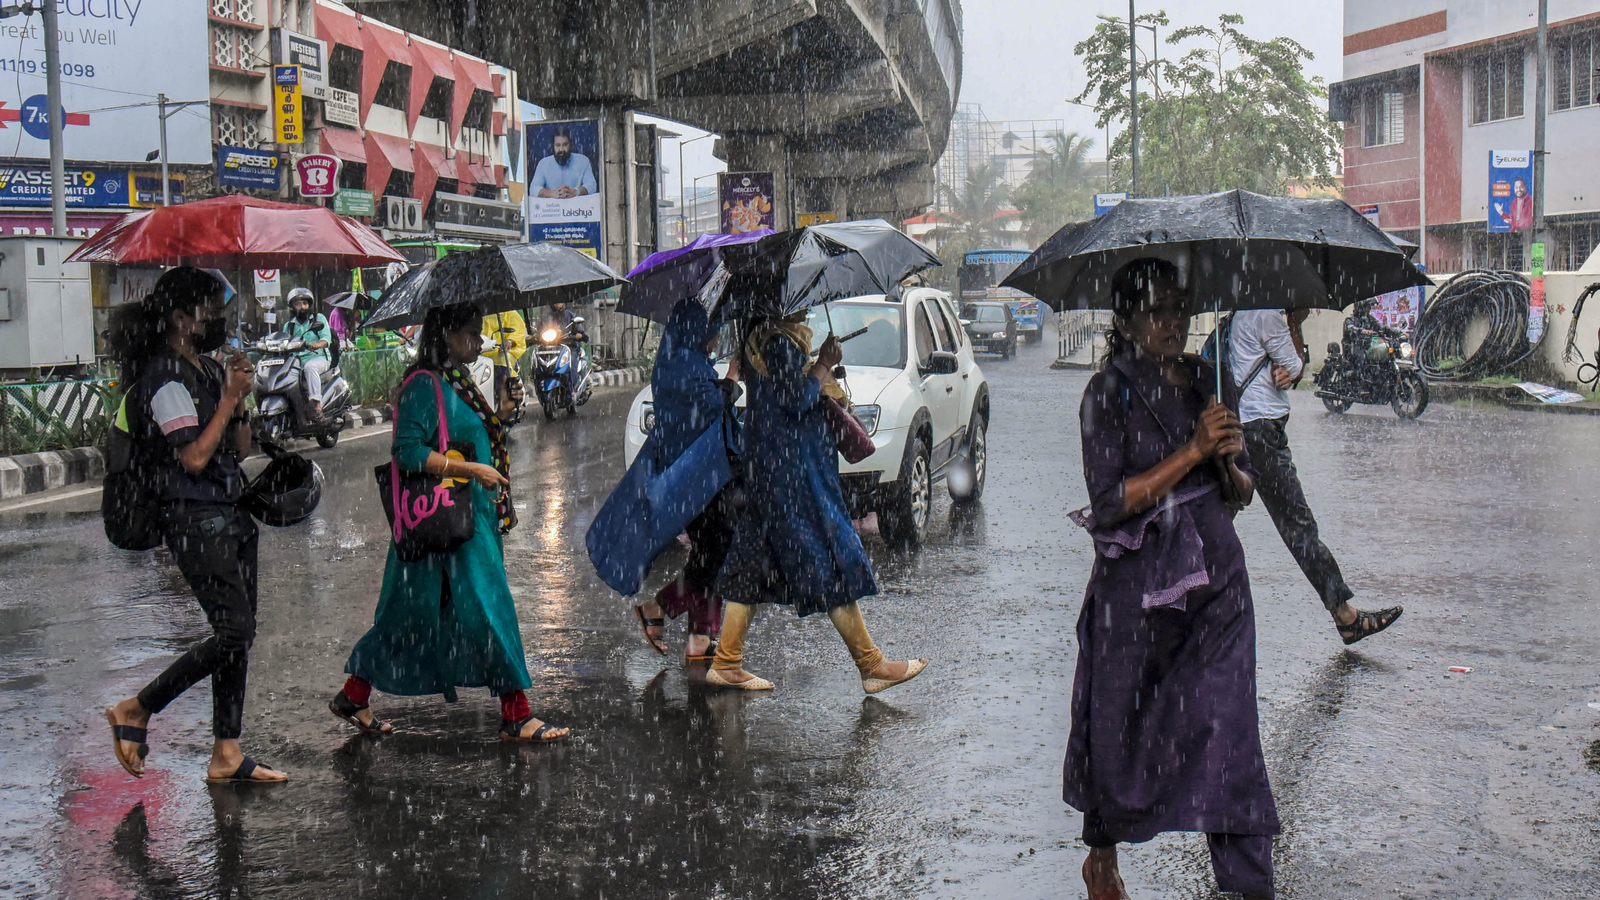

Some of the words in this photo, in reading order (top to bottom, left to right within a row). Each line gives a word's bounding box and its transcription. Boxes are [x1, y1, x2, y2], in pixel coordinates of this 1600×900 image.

[0, 23, 38, 40] reat
[57, 29, 74, 43] ou
[79, 28, 116, 46] Well
[290, 42, 317, 57] WESTERN
[299, 53, 317, 68] UNION
[41, 61, 95, 78] 9098
[303, 70, 322, 82] TRANSFER
[313, 87, 325, 97] KSFE
[332, 89, 348, 104] KSFE
[301, 158, 333, 169] BAKERY
[10, 185, 53, 195] CREDITS
[65, 186, 96, 195] MITED
